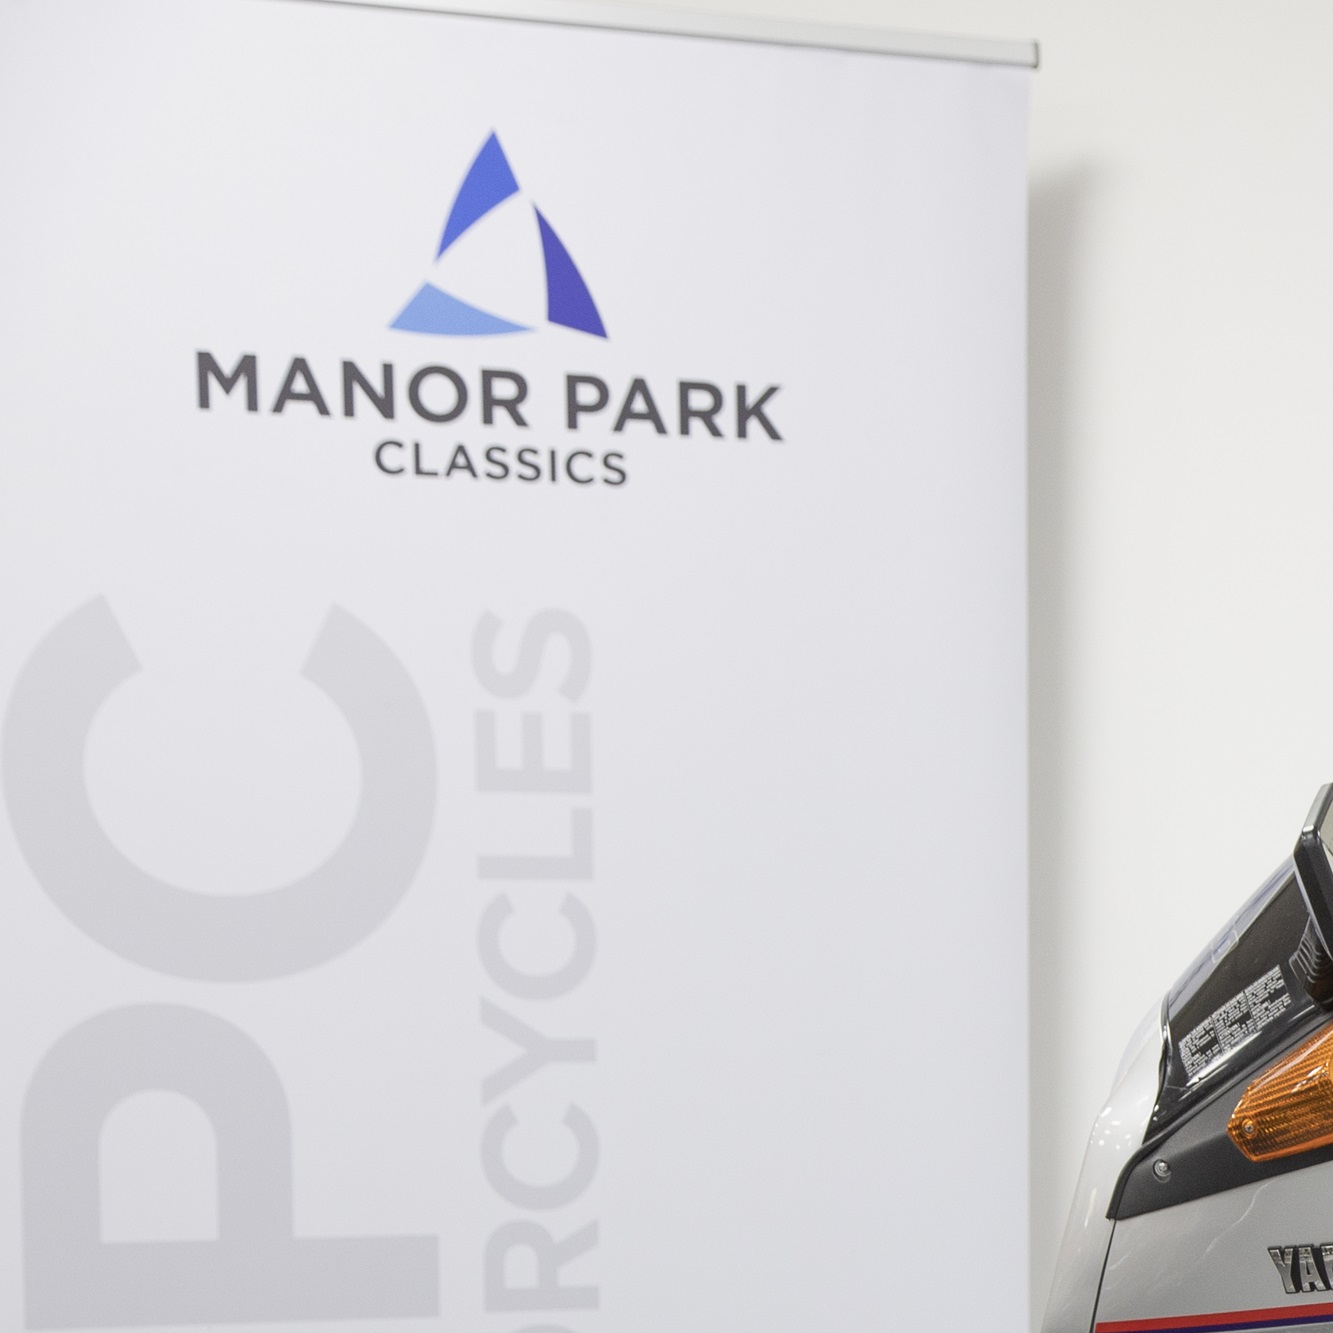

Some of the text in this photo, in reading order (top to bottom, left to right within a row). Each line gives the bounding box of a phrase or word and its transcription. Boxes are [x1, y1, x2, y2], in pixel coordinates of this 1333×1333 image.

[197, 350, 782, 442] MANOR PARK
[374, 440, 627, 486] CLASSICS
